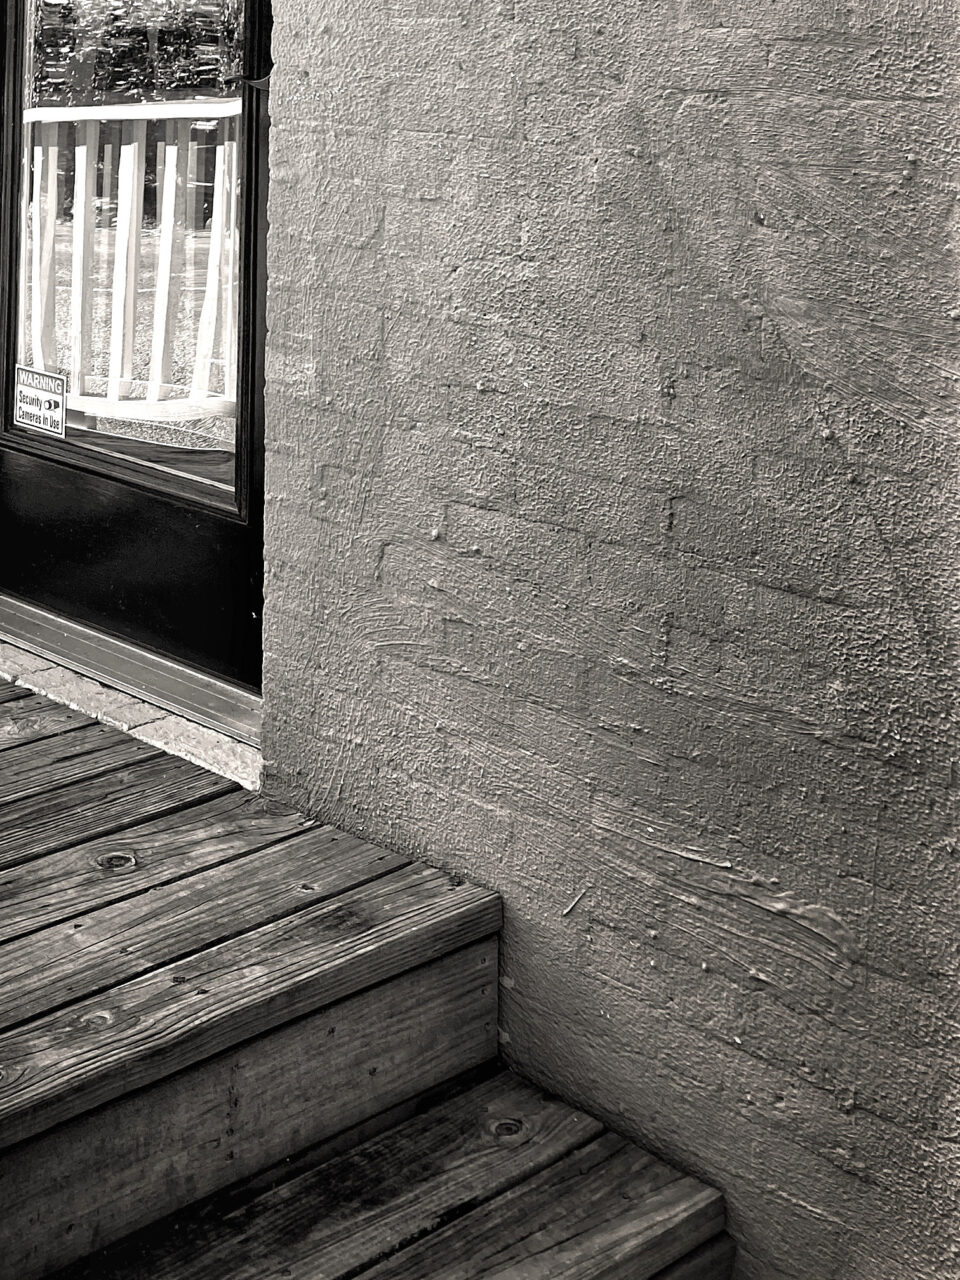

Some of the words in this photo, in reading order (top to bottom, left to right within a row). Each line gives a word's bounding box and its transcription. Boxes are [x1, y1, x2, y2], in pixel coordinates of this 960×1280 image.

[19, 370, 62, 394] WARNING
[18, 390, 42, 411] Security
[18, 406, 42, 425] Cameras
[49, 415, 60, 430] Use
